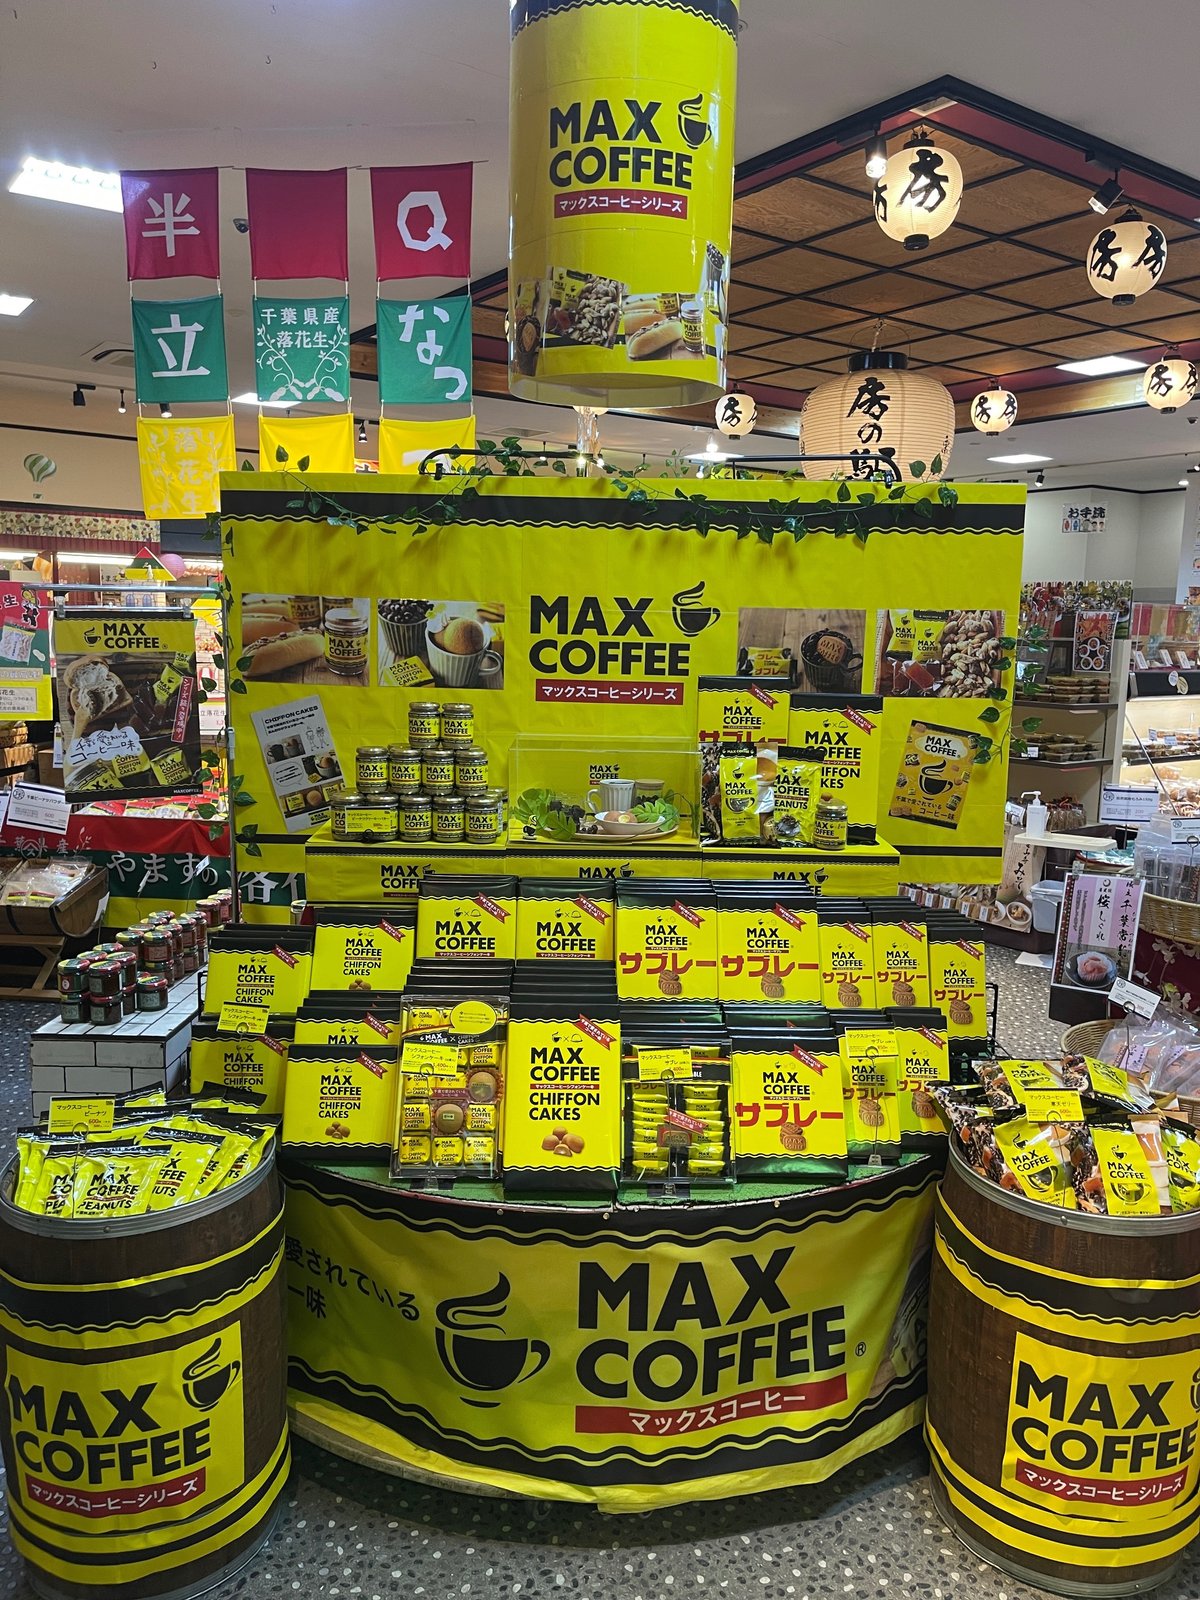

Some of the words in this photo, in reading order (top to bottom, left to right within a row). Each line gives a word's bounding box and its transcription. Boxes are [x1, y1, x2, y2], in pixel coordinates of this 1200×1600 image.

[550, 99, 662, 148] MAX
[550, 146, 692, 189] COFFEE
[559, 195, 683, 213] マックスコーヒーシリーズ
[142, 192, 201, 257] 半
[397, 191, 453, 251] Q
[260, 306, 340, 326] 千葉県産
[151, 313, 210, 378] 立
[276, 331, 329, 349] 落花生
[172, 427, 206, 515] 落花生
[530, 595, 654, 637] MAX
[103, 623, 147, 636] MAX
[895, 627, 912, 635] MAX
[104, 637, 159, 649] COFFEE
[329, 638, 354, 648] MAX
[329, 647, 361, 656] COFFEE
[529, 639, 690, 676] COFFEE
[390, 661, 410, 671] MAX
[392, 664, 419, 675] COFFEE
[396, 670, 423, 681] CHIFFON
[542, 686, 677, 700] マックスコーヒーシリーズ
[265, 712, 295, 724] CHIFFON
[296, 705, 318, 716] CAKES
[723, 706, 752, 715] MAX
[723, 717, 762, 725] COFFEE
[805, 731, 848, 745] MAX
[926, 736, 952, 748] MAX
[924, 744, 957, 757] COFFEE
[159, 757, 176, 769] MAX
[590, 765, 611, 773] MAX
[459, 767, 478, 775] MAX
[822, 767, 860, 778] IFFON
[821, 779, 844, 788] KES
[381, 865, 419, 877] MAX
[579, 867, 616, 878] MAX
[435, 921, 482, 935] MAX
[536, 922, 582, 936] MAX
[645, 925, 677, 935] MAX
[746, 928, 779, 938] MAX
[346, 939, 374, 947] MAX
[435, 937, 495, 949] COFFEE
[536, 938, 595, 951] COFFEE
[645, 936, 688, 946] COFFEE
[746, 939, 790, 949] COFFEE
[345, 948, 382, 956] COFFEE
[344, 960, 381, 969] CHIFFON
[619, 952, 716, 974] サブレー
[721, 955, 819, 977] サブレー
[238, 965, 267, 974] MAX
[944, 969, 968, 977] MAX
[237, 975, 275, 983] COFFEE
[822, 972, 873, 984] サブレー
[877, 971, 927, 983] サブレー
[236, 988, 274, 996] CHIFFON
[934, 989, 985, 1001] サブレー
[328, 1035, 358, 1044] MAX
[224, 1053, 254, 1063] MAX
[530, 1047, 584, 1064] MAX
[224, 1064, 264, 1072] COFFEE
[906, 1058, 930, 1066] MAX
[530, 1066, 600, 1081] COFFEE
[763, 1072, 798, 1083] MAX
[321, 1075, 352, 1085] MAX
[320, 1087, 361, 1096] COFFEE
[764, 1085, 810, 1094] COFFEE
[843, 1087, 895, 1099] サブレー
[529, 1093, 600, 1105] CHIFFON
[319, 1101, 361, 1110] CHIFFON
[319, 1110, 349, 1118] CAKES
[529, 1108, 581, 1120] CAKES
[735, 1103, 843, 1127] サブレー
[1012, 1150, 1039, 1165] MAX
[1016, 1155, 1051, 1172] COFFEE
[1108, 1161, 1134, 1172] MAX
[91, 1173, 131, 1186] MAX
[1110, 1171, 1146, 1180] COFFEE
[87, 1185, 139, 1197] COFFEE
[78, 1199, 132, 1211] PEANUTS
[578, 1246, 796, 1332] MAX
[576, 1305, 846, 1403] COFFEE
[1015, 1360, 1175, 1430] MAX
[9, 1374, 161, 1438] MAX
[628, 1391, 806, 1435] マックスコーヒー
[15, 1418, 211, 1484] COFFEE
[1011, 1417, 1199, 1474] COFFEE
[1024, 1469, 1183, 1501] マックスコーヒーシリーズ
[30, 1477, 198, 1511] マックスコーヒーシリーズ
